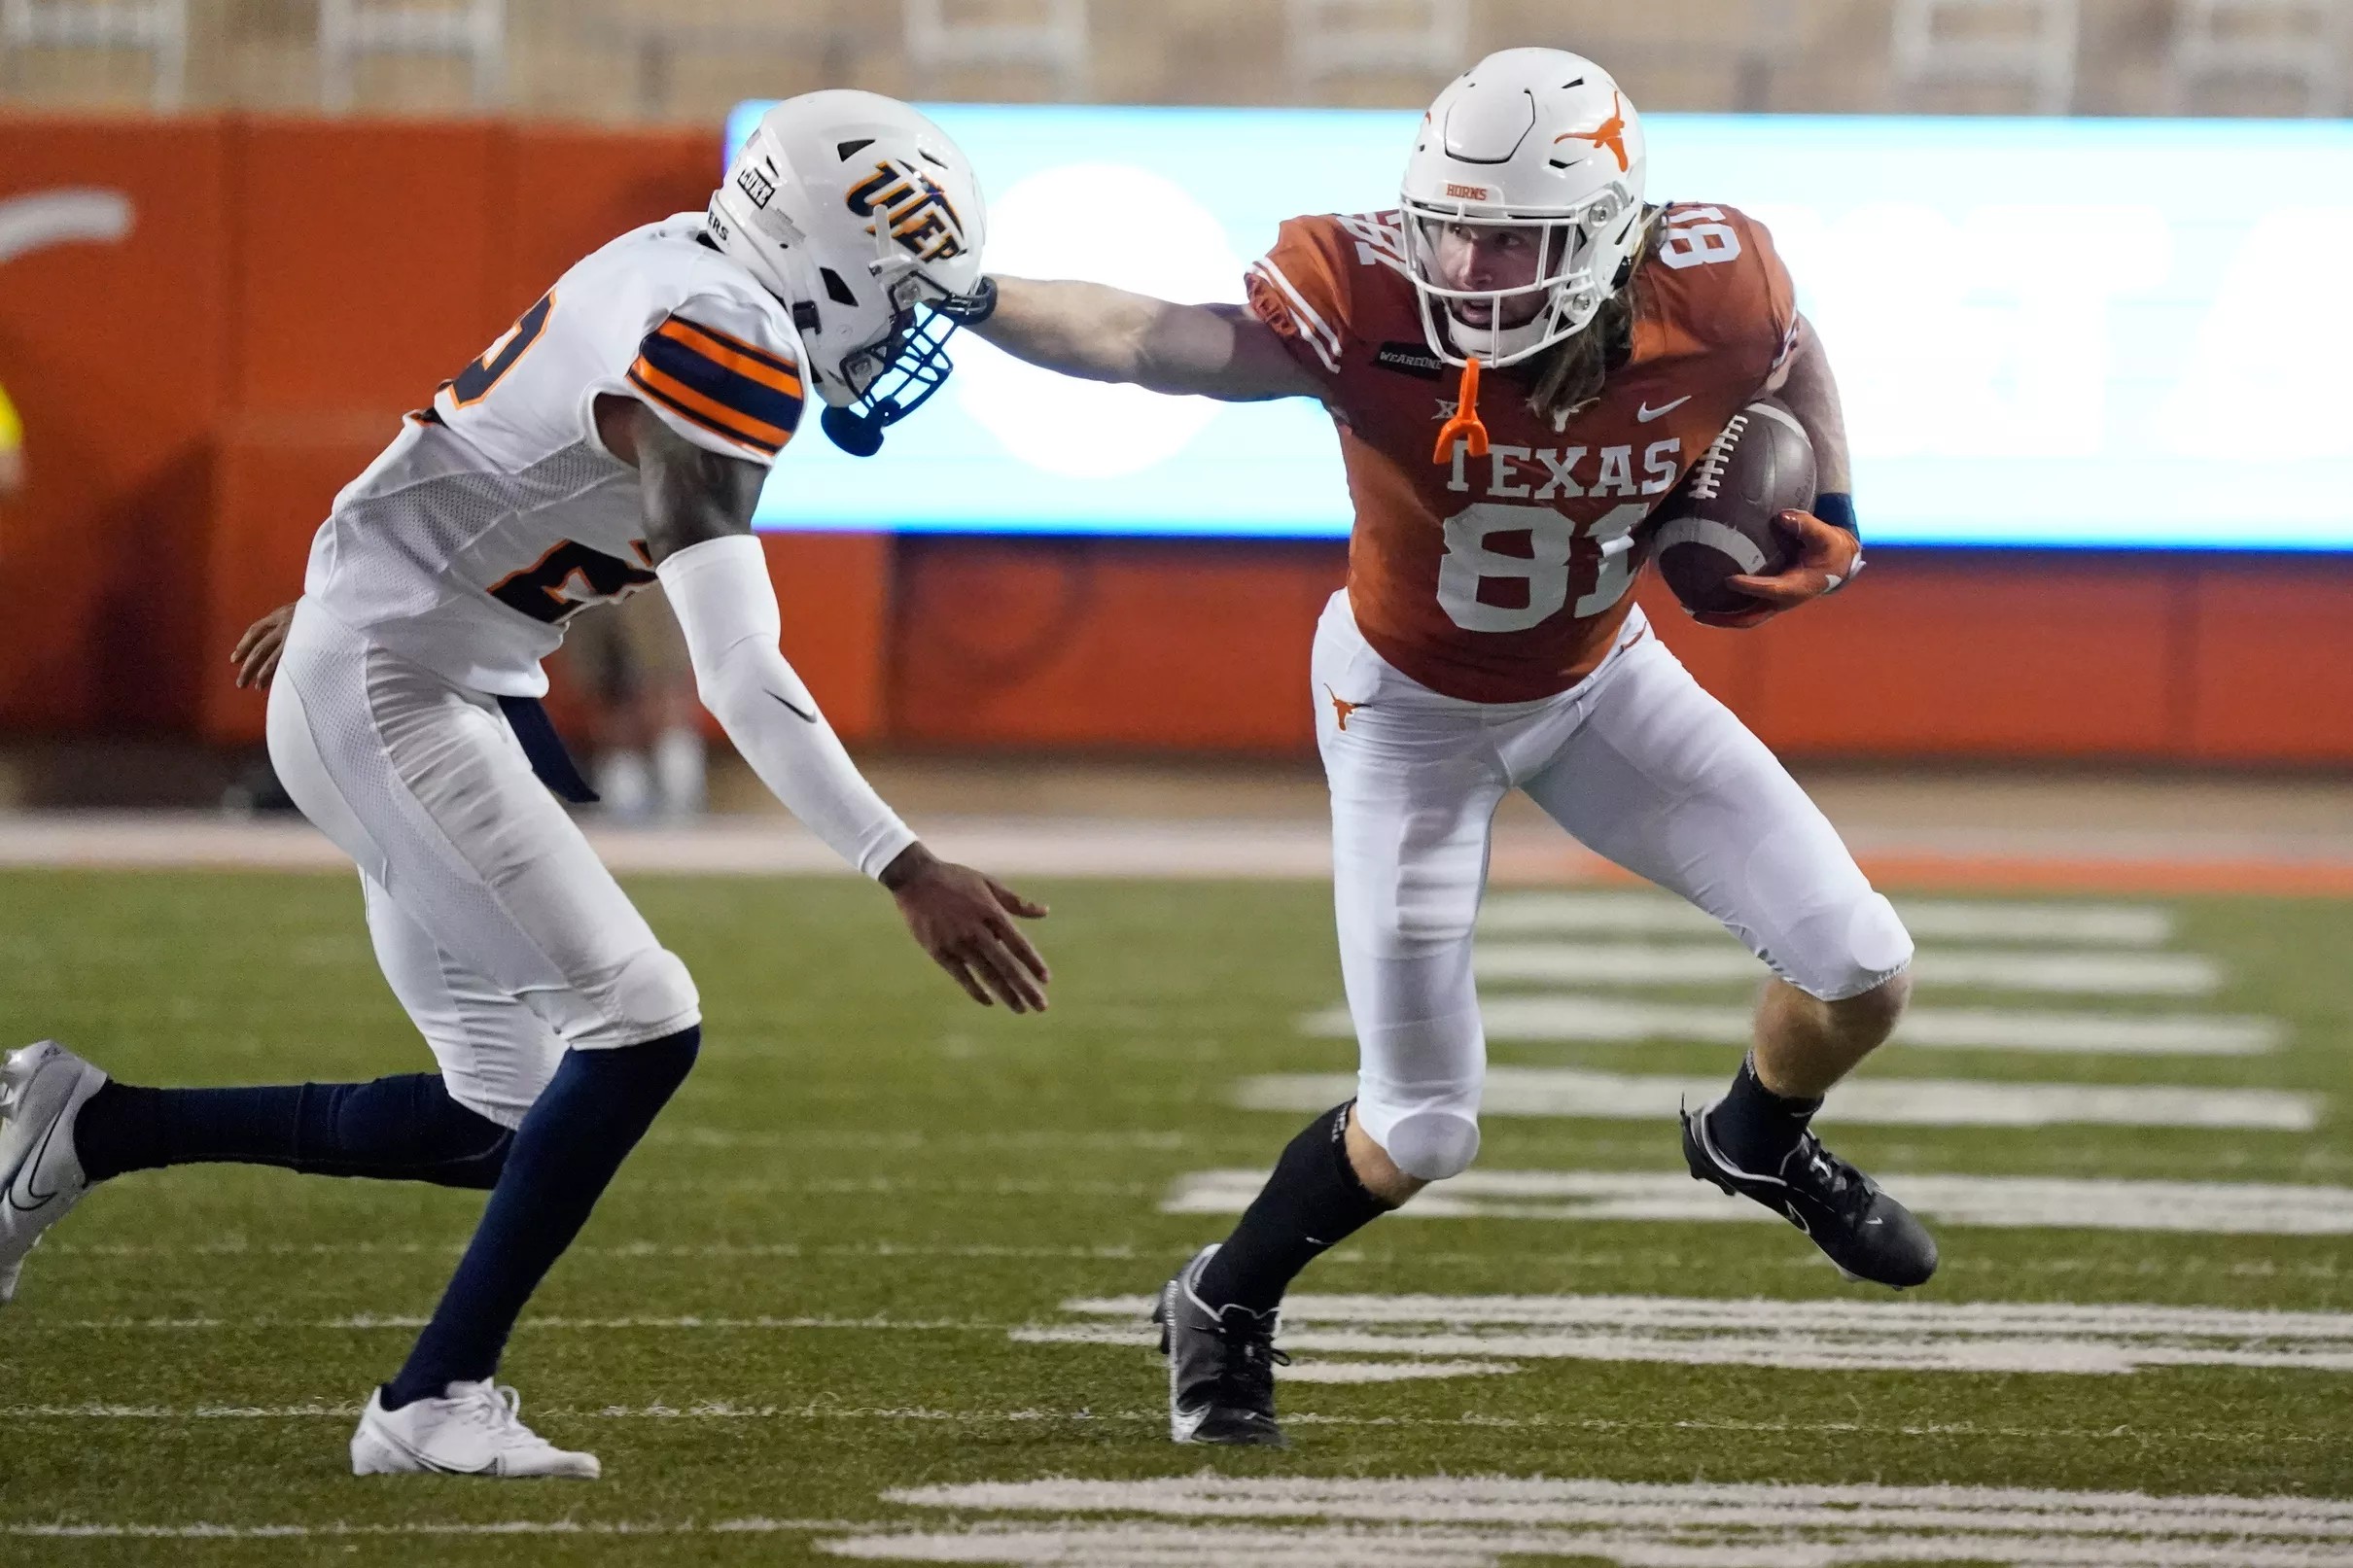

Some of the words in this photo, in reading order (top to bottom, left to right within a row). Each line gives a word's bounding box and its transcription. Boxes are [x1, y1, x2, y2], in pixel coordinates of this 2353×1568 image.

[1447, 184, 1487, 200] HORNS
[1447, 437, 1680, 500] TEXAS
[1436, 503, 1651, 633] 81
